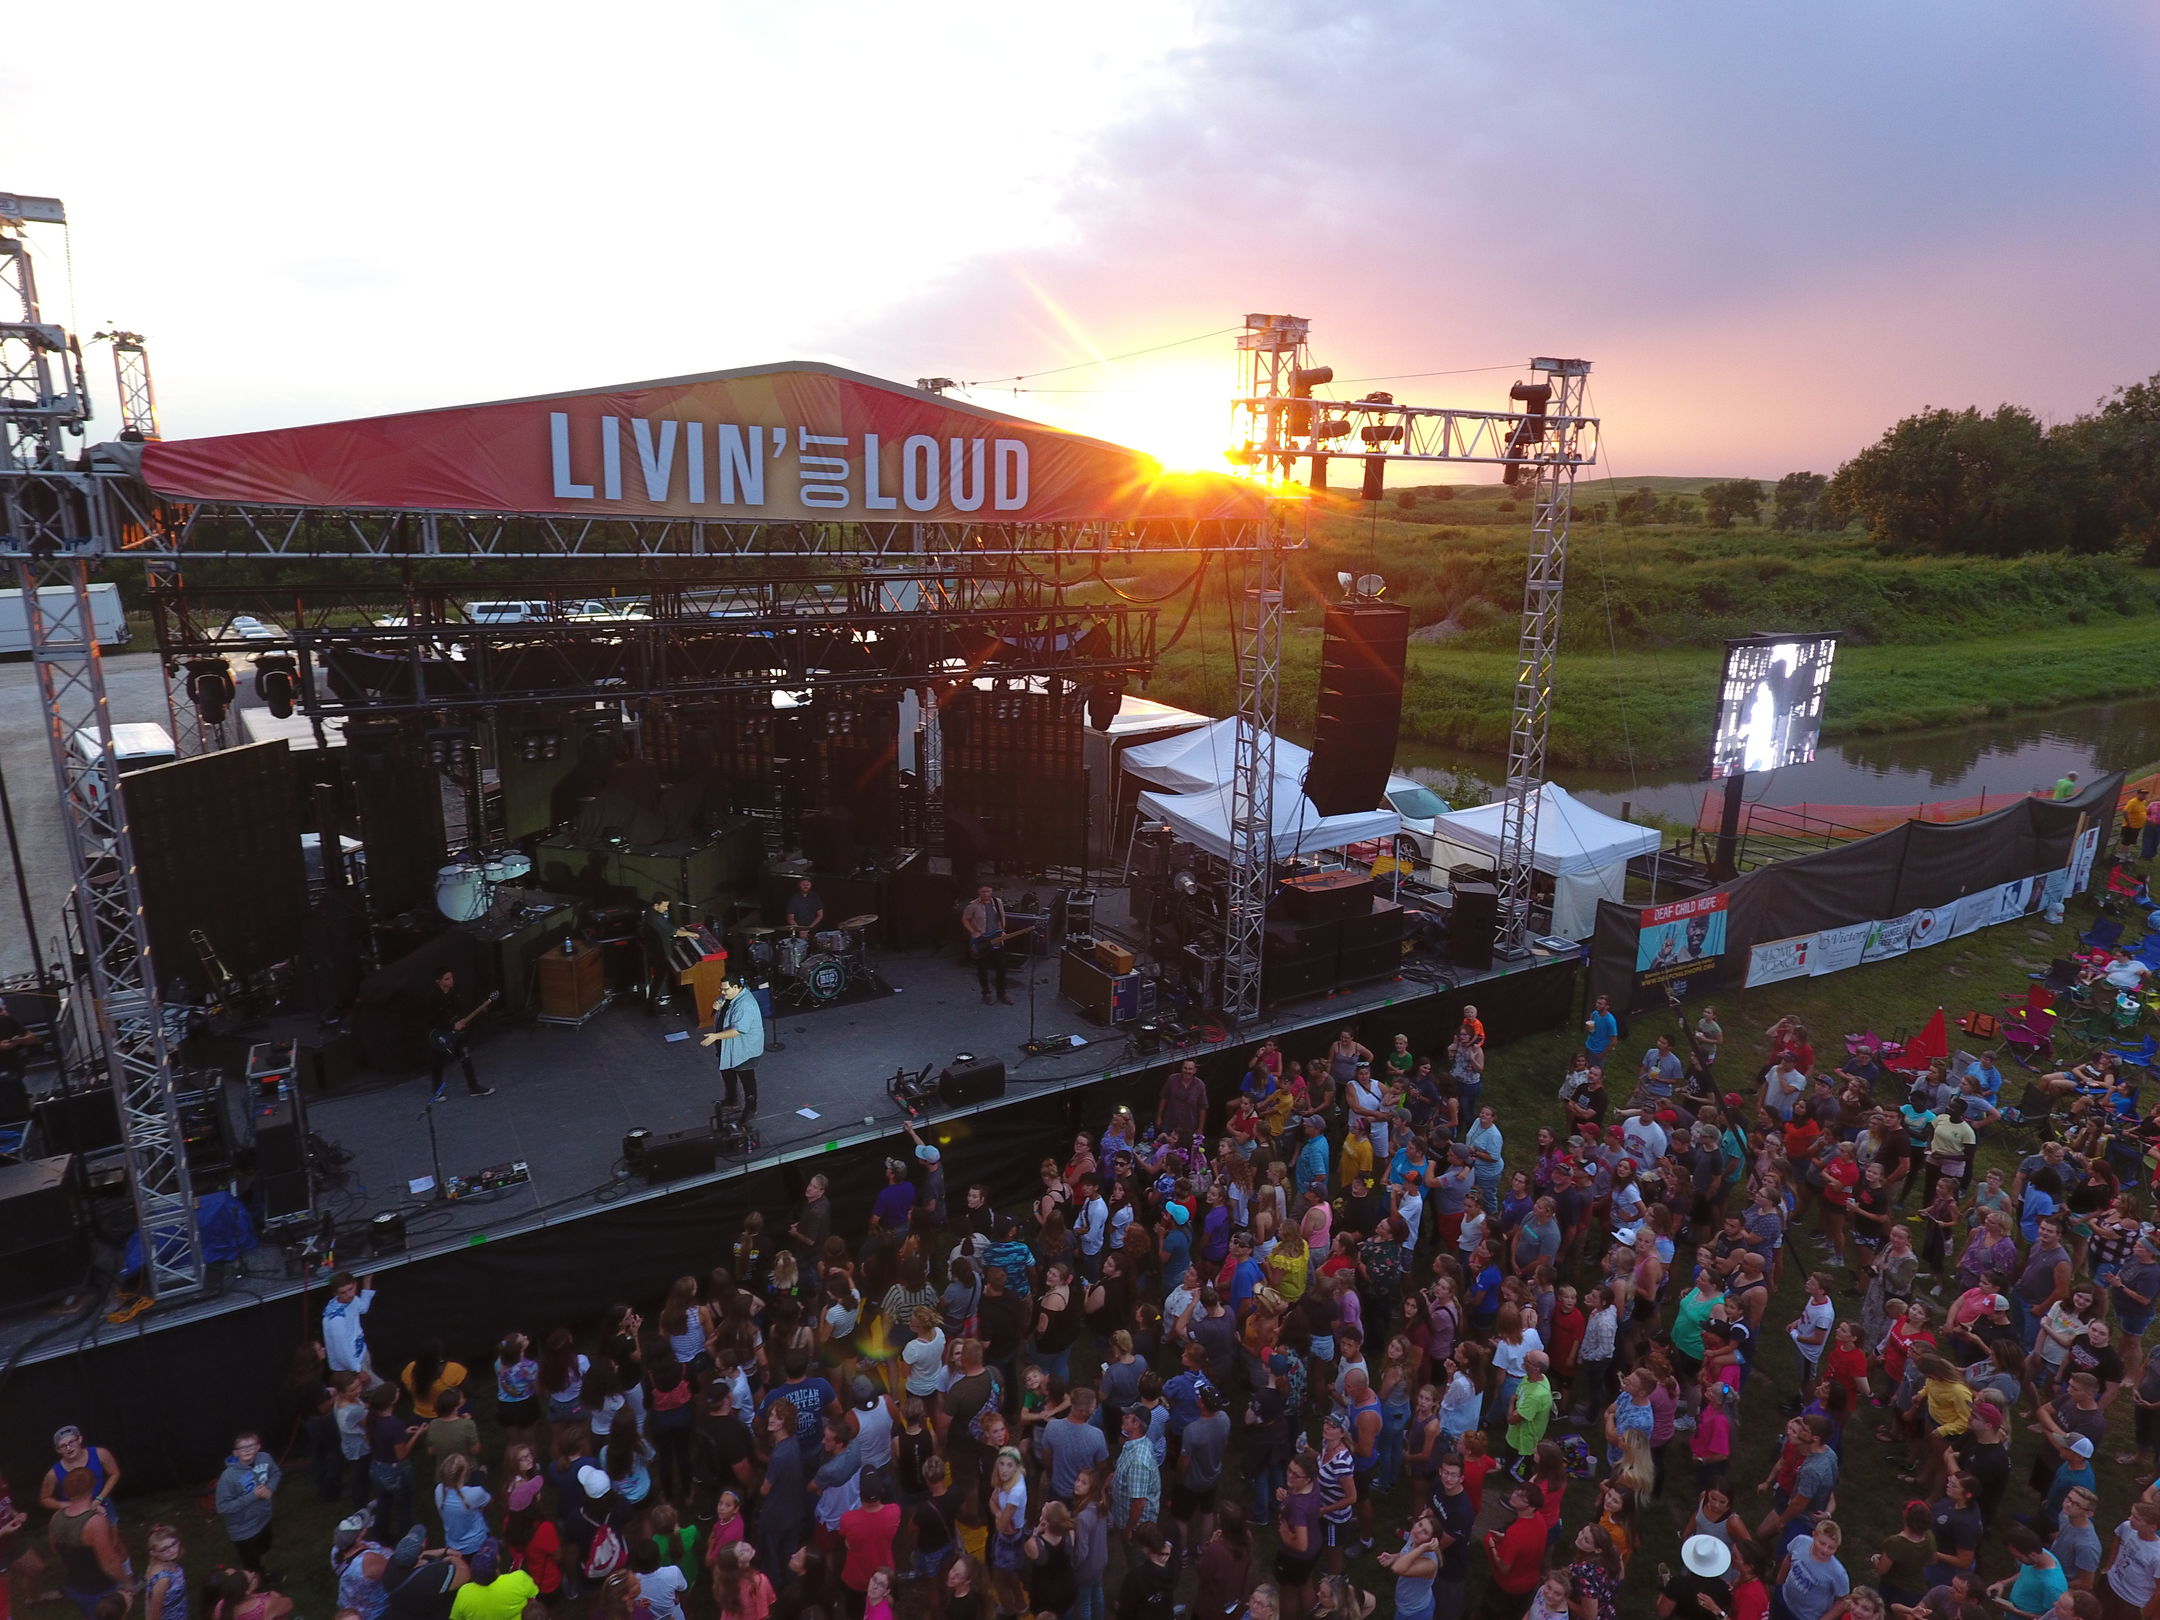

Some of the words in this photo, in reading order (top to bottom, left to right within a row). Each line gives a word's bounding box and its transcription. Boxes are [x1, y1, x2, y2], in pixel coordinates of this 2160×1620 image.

[550, 412, 787, 506] LIVIN'
[800, 426, 851, 509] OUT
[865, 433, 1031, 512] LOUD
[1654, 906, 1674, 921] DEAF
[1675, 901, 1696, 917] CHILD
[1697, 896, 1717, 911] HOPE
